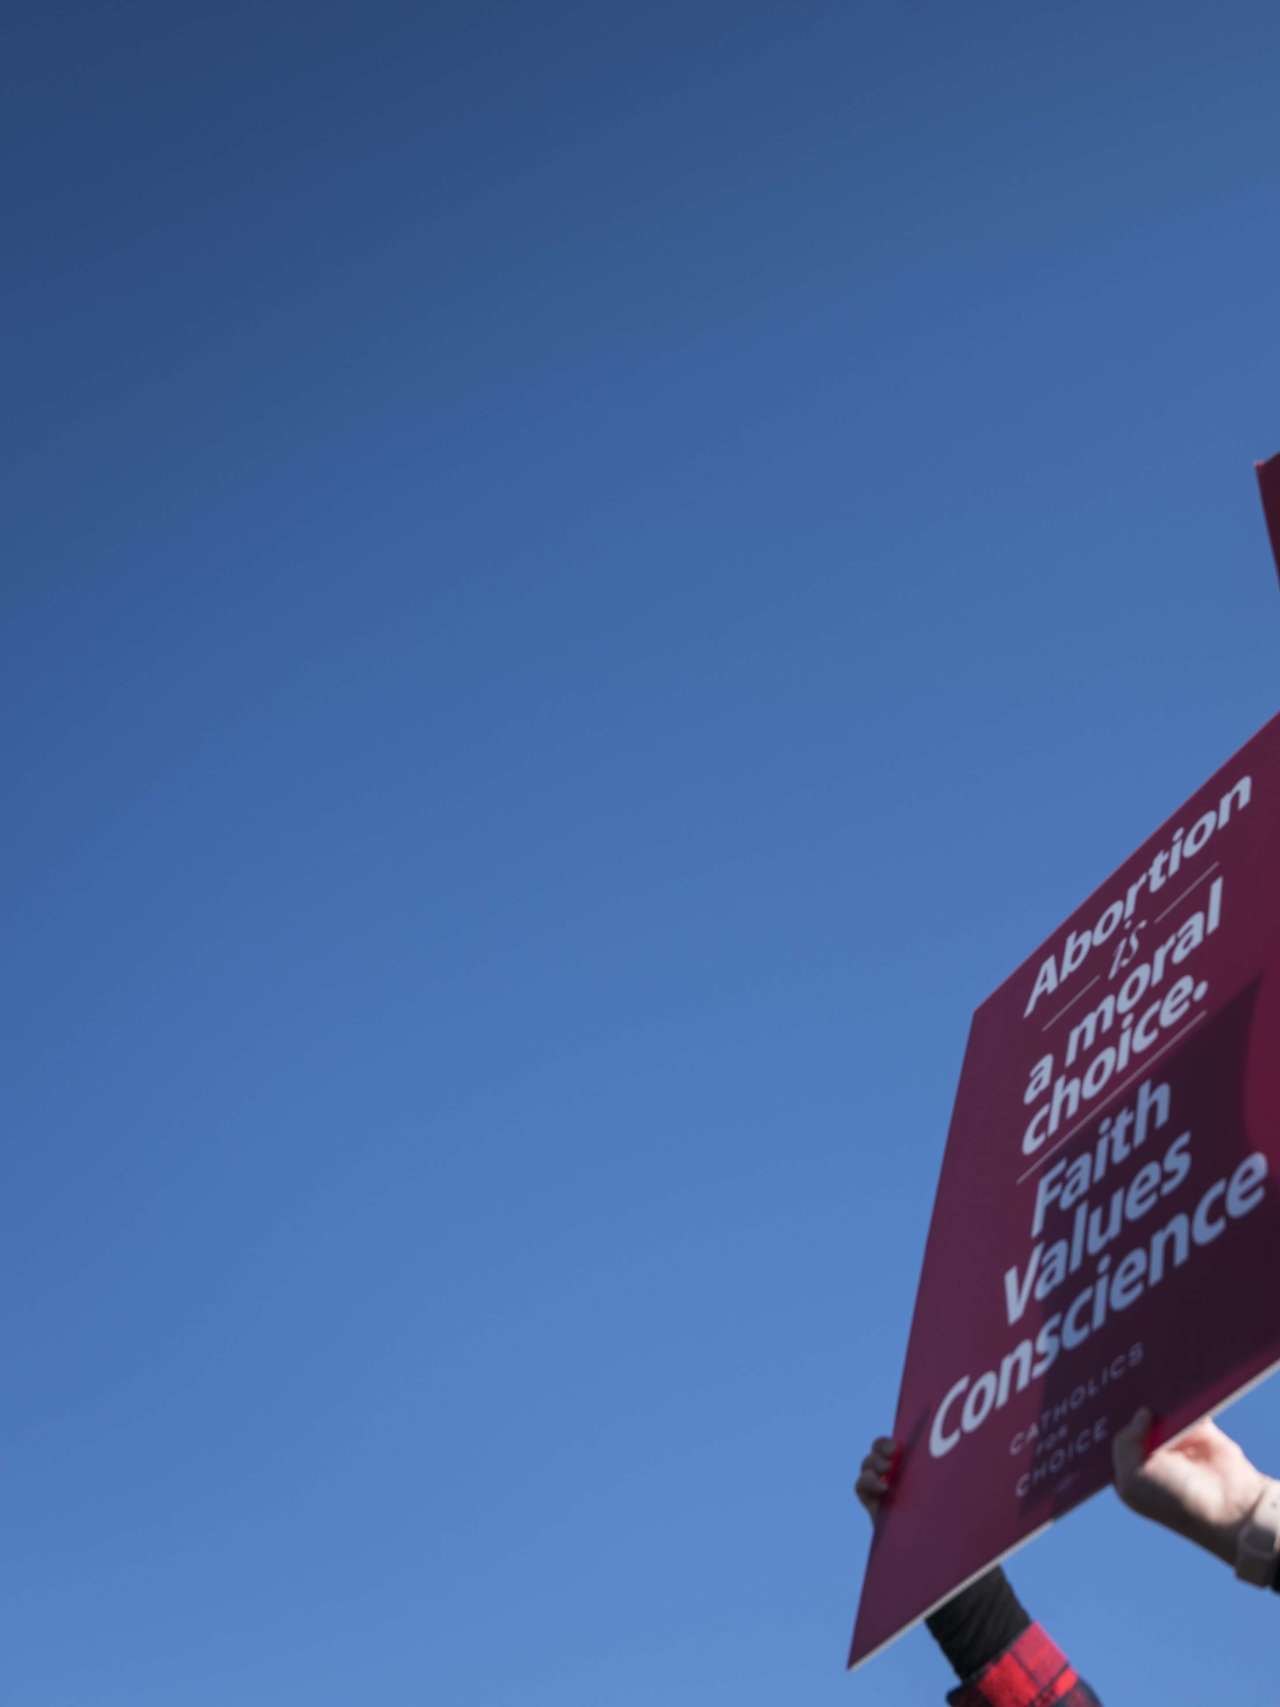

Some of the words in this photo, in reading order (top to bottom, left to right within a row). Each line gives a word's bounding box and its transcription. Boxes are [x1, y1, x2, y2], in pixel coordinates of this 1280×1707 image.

[1024, 775, 1253, 1019] Abortion
[1107, 918, 1147, 982] is
[1022, 974, 1209, 1156] choice.
[1023, 1053, 1055, 1106] a
[1063, 877, 1224, 1068] moral
[1003, 1132, 1192, 1326] Values
[1031, 1080, 1172, 1238] Faith
[928, 1152, 1268, 1460] Conscience
[1009, 1343, 1144, 1456] CATHOLICS
[1014, 1419, 1110, 1498] CHOICE
